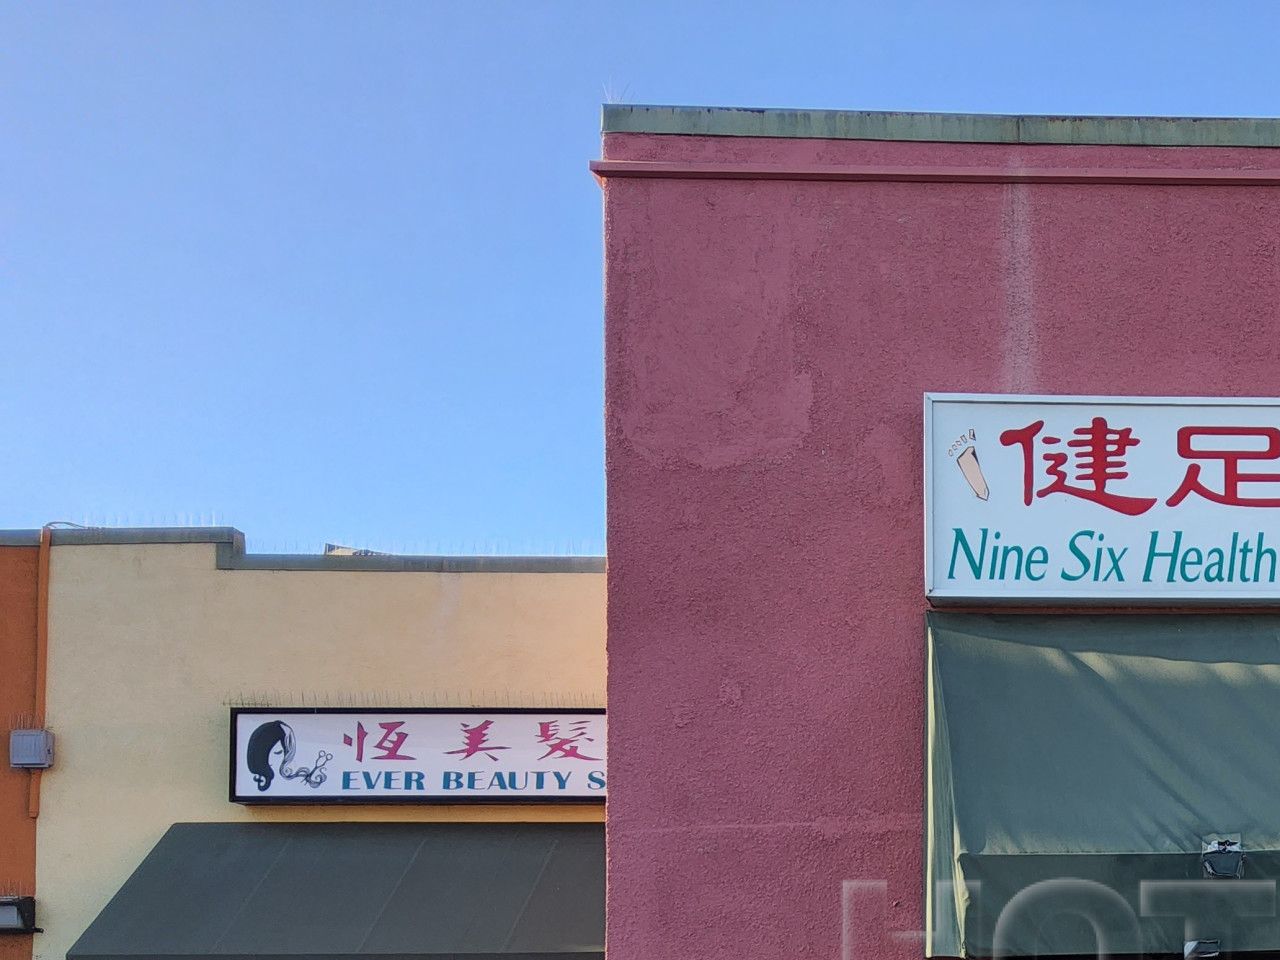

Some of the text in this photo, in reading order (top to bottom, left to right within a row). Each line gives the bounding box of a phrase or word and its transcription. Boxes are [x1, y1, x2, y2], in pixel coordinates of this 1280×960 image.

[946, 527, 1049, 582] Nine
[1059, 528, 1126, 583] Six
[1142, 528, 1278, 584] Health
[341, 771, 425, 791] EVER
[441, 770, 573, 791] BEAUTY
